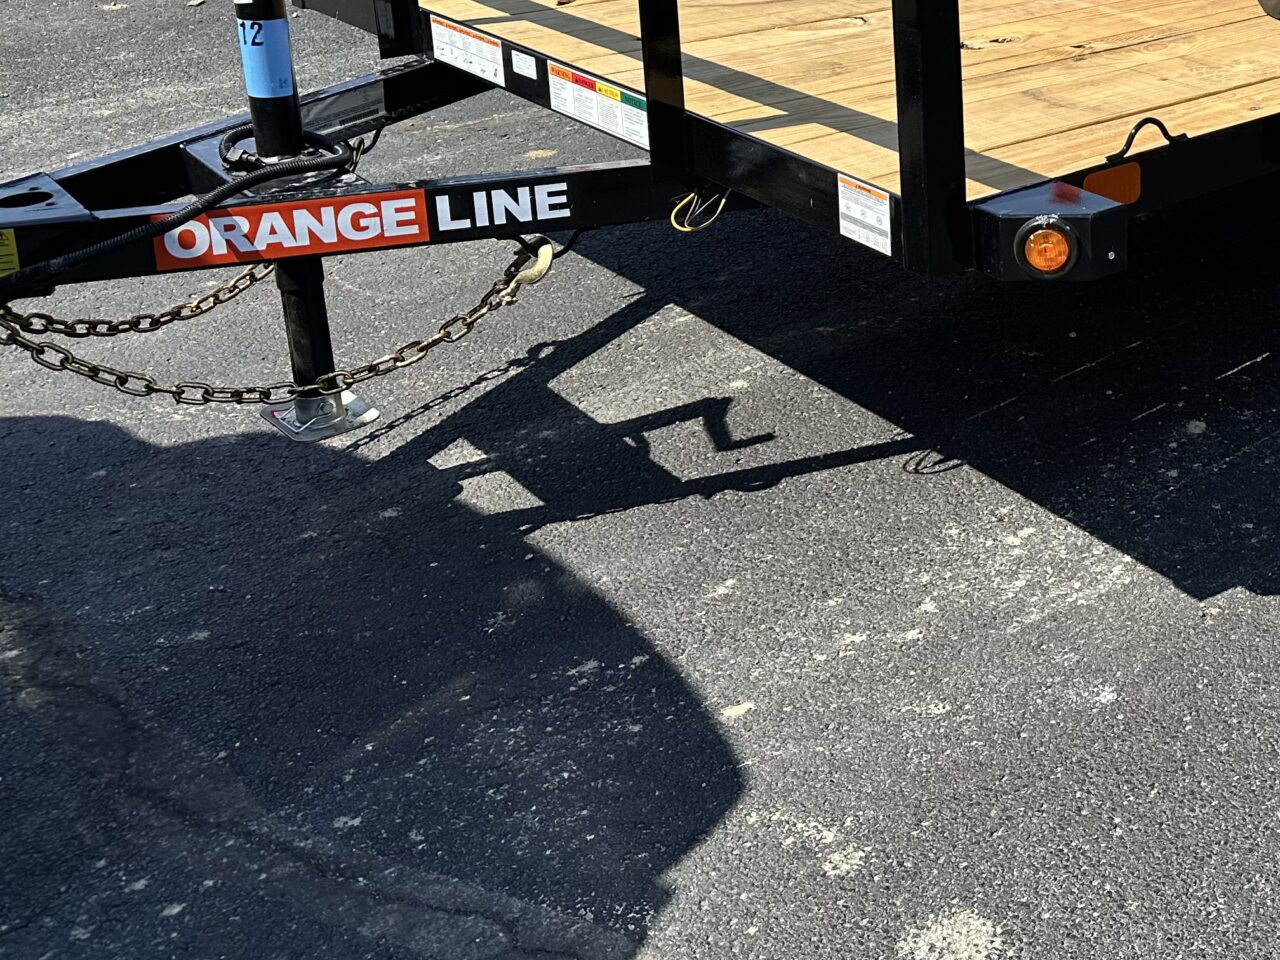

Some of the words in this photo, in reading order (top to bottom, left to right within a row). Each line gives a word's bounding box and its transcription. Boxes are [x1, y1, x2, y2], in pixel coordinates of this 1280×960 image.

[239, 21, 264, 47] 12
[163, 198, 420, 259] ORANGE
[435, 182, 571, 232] LINE
